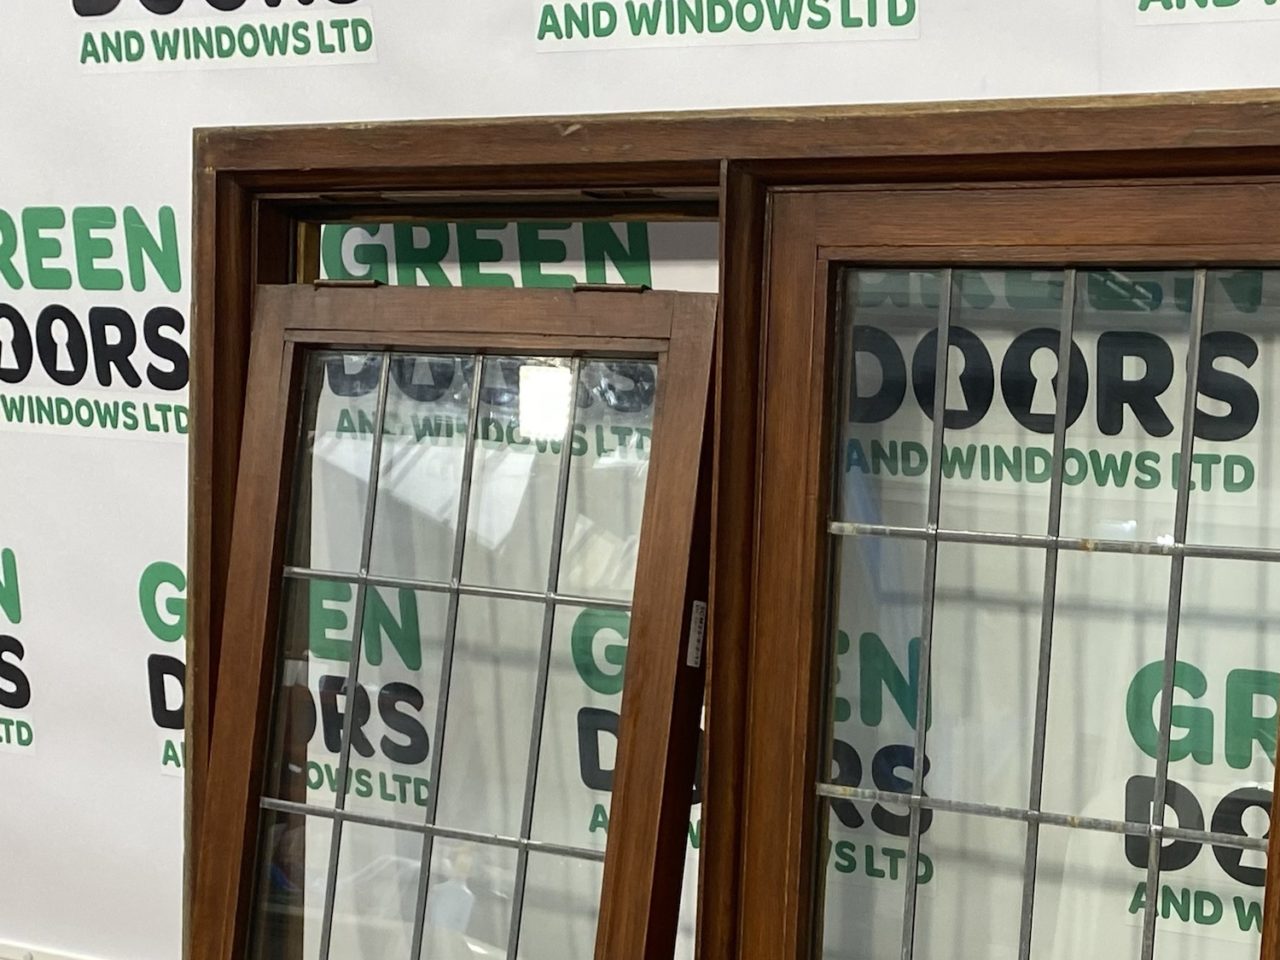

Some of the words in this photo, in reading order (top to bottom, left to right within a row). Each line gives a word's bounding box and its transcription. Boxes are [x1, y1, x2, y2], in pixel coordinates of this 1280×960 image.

[80, 31, 145, 64] AND
[150, 21, 311, 60] WINDOWS
[316, 18, 373, 53] LTD
[536, 2, 617, 40] AND
[624, 0, 831, 36] WINDOWS
[322, 222, 653, 289] GREEN
[848, 324, 1260, 442] DOORS
[0, 394, 140, 431] WINDOWS
[143, 402, 189, 434] LTD
[845, 438, 928, 478] AND
[940, 443, 1162, 490] WINDOWS
[1171, 452, 1255, 493] LTD
[379, 770, 432, 807] LTD
[864, 844, 934, 885] LTD
[1128, 881, 1224, 926] AND
